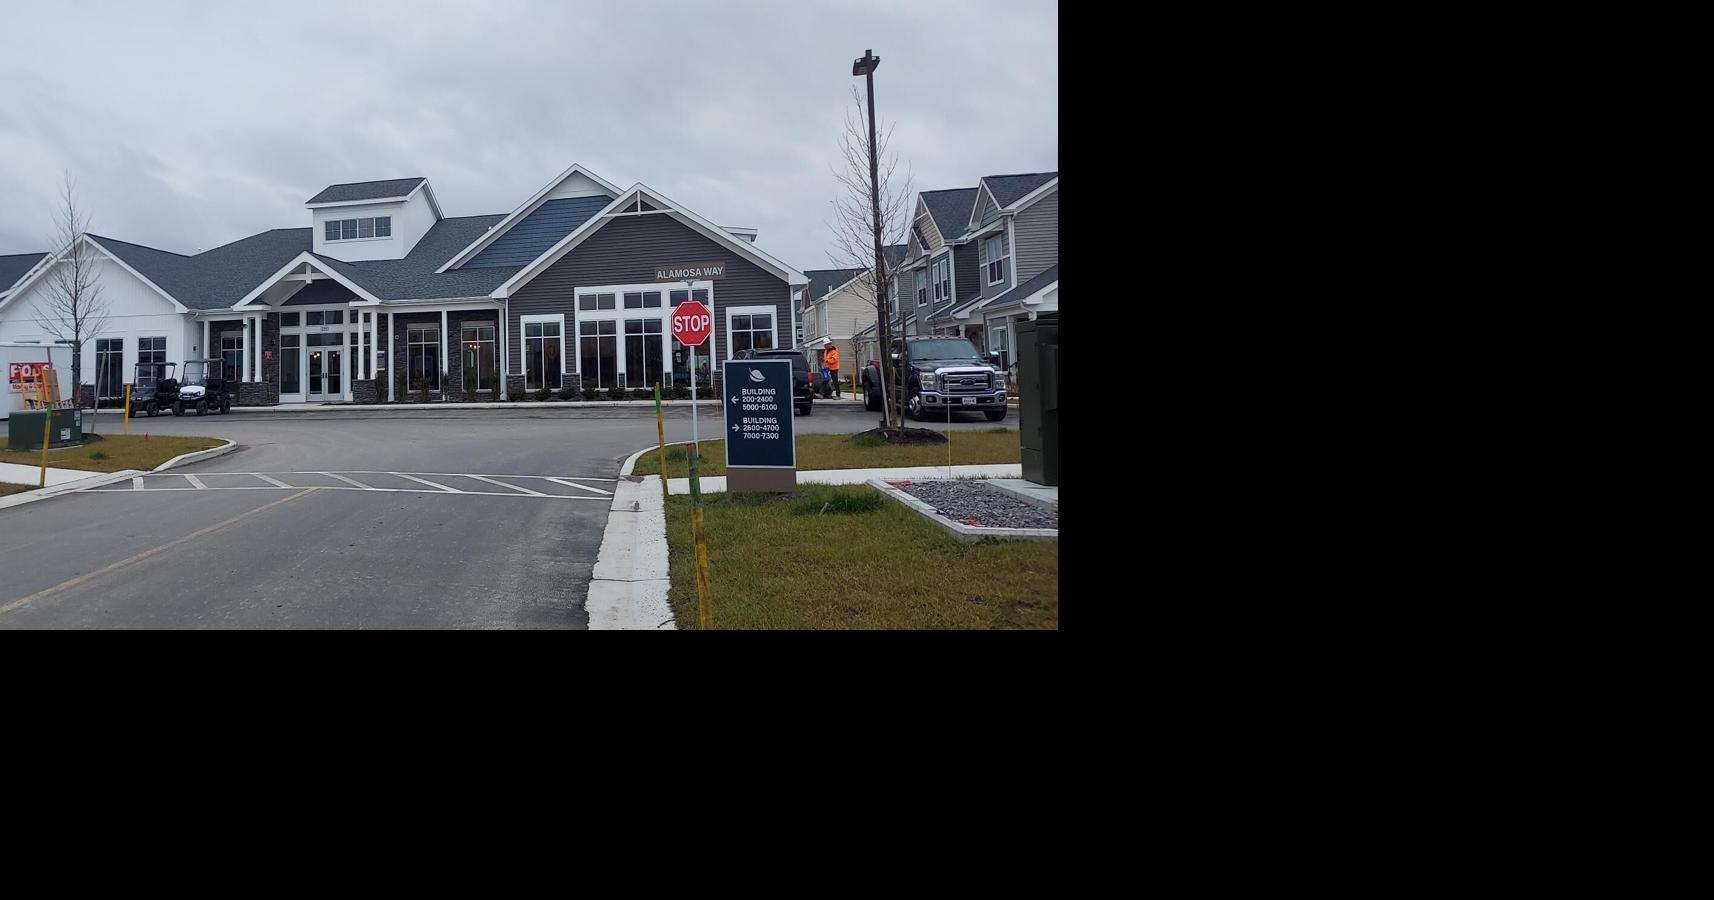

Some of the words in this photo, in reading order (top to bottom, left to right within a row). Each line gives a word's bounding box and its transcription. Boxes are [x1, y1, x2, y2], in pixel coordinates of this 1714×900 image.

[657, 268, 702, 279] ALAMOSA
[703, 266, 723, 276] WAY
[674, 315, 709, 332] STOP
[742, 395, 774, 403] 200-2400
[742, 403, 778, 411] 5000-6100
[743, 432, 780, 440] 7000-7300
